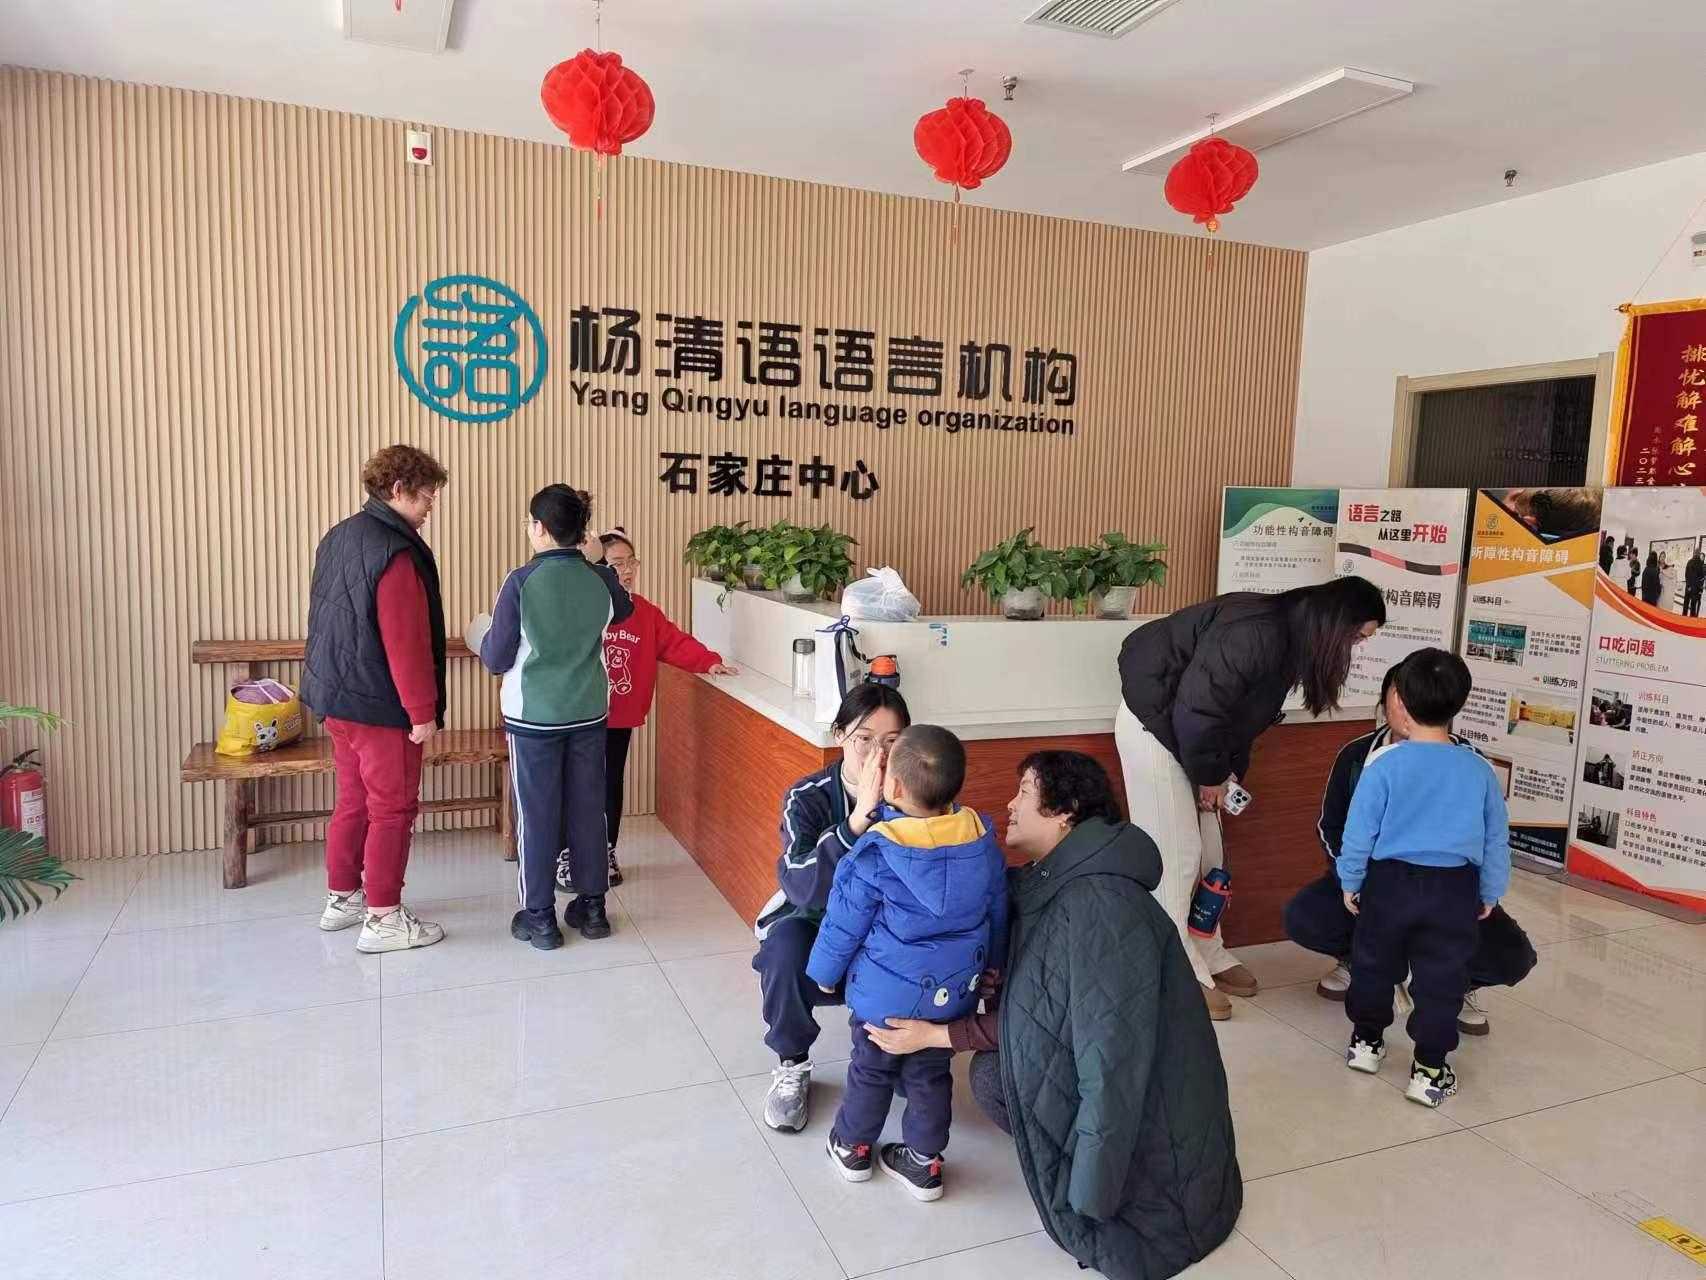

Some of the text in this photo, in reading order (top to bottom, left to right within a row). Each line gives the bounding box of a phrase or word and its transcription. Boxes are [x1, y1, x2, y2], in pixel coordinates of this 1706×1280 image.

[570, 306, 1078, 406] 杨清语语言机构
[570, 381, 1074, 435] Yang Qingyu language organization
[1668, 344, 1706, 486] 排忧解难解心
[659, 451, 880, 500] 石家庄中心
[1348, 504, 1402, 522] 语言之路
[1254, 525, 1334, 538] 功能性构音障碍
[1378, 524, 1447, 543] 从这里开始
[1383, 588, 1441, 609] 构音障碍
[619, 630, 641, 644] Bear
[1599, 636, 1656, 657] 口吃问题
[1636, 662, 1669, 672] PROBLEM
[1543, 675, 1578, 688] 训练方向
[1460, 728, 1489, 743] 科目特色
[1627, 808, 1657, 823] 科目特色
